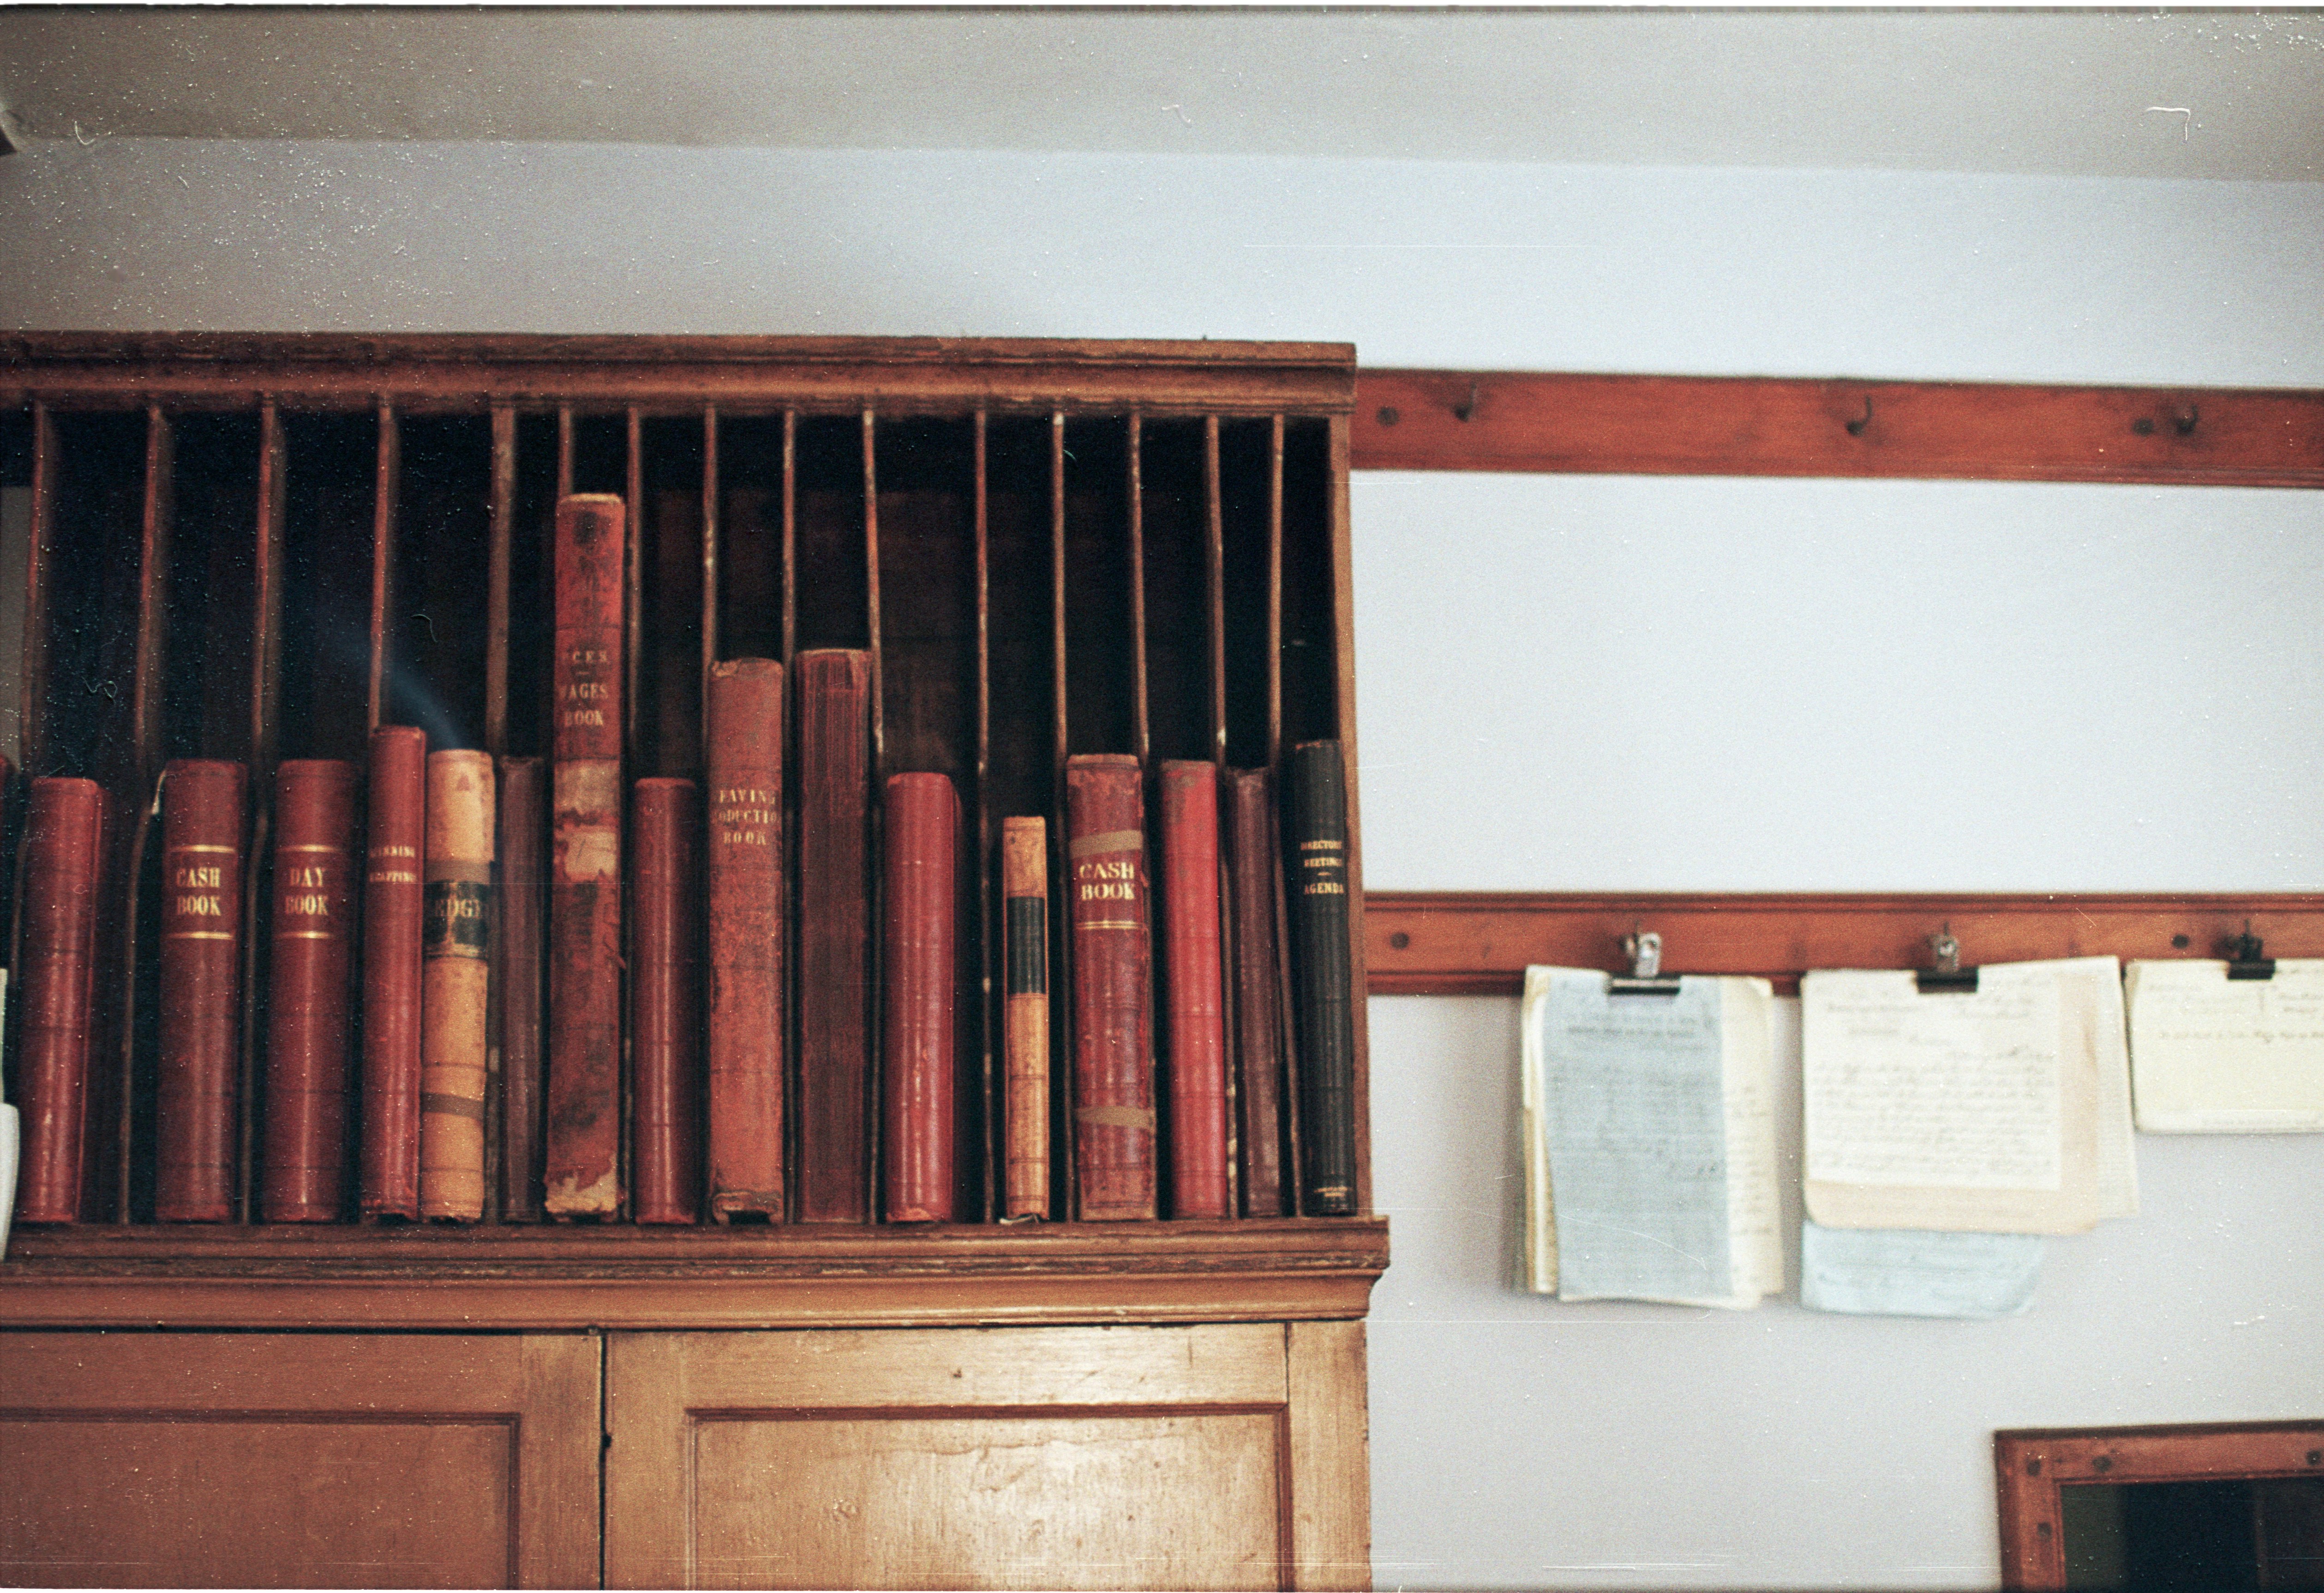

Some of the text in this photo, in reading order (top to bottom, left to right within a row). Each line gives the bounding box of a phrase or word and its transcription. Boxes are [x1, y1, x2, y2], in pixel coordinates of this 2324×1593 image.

[564, 709, 604, 727] BOOK
[724, 831, 767, 845] BOOK
[176, 867, 221, 888] CASH
[289, 867, 326, 888] DAY
[1079, 862, 1135, 879] CASH
[1081, 882, 1135, 900] BOOK
[1304, 882, 1344, 894] AGENDA
[176, 895, 221, 916] BOOK
[285, 894, 329, 916] BOOK
